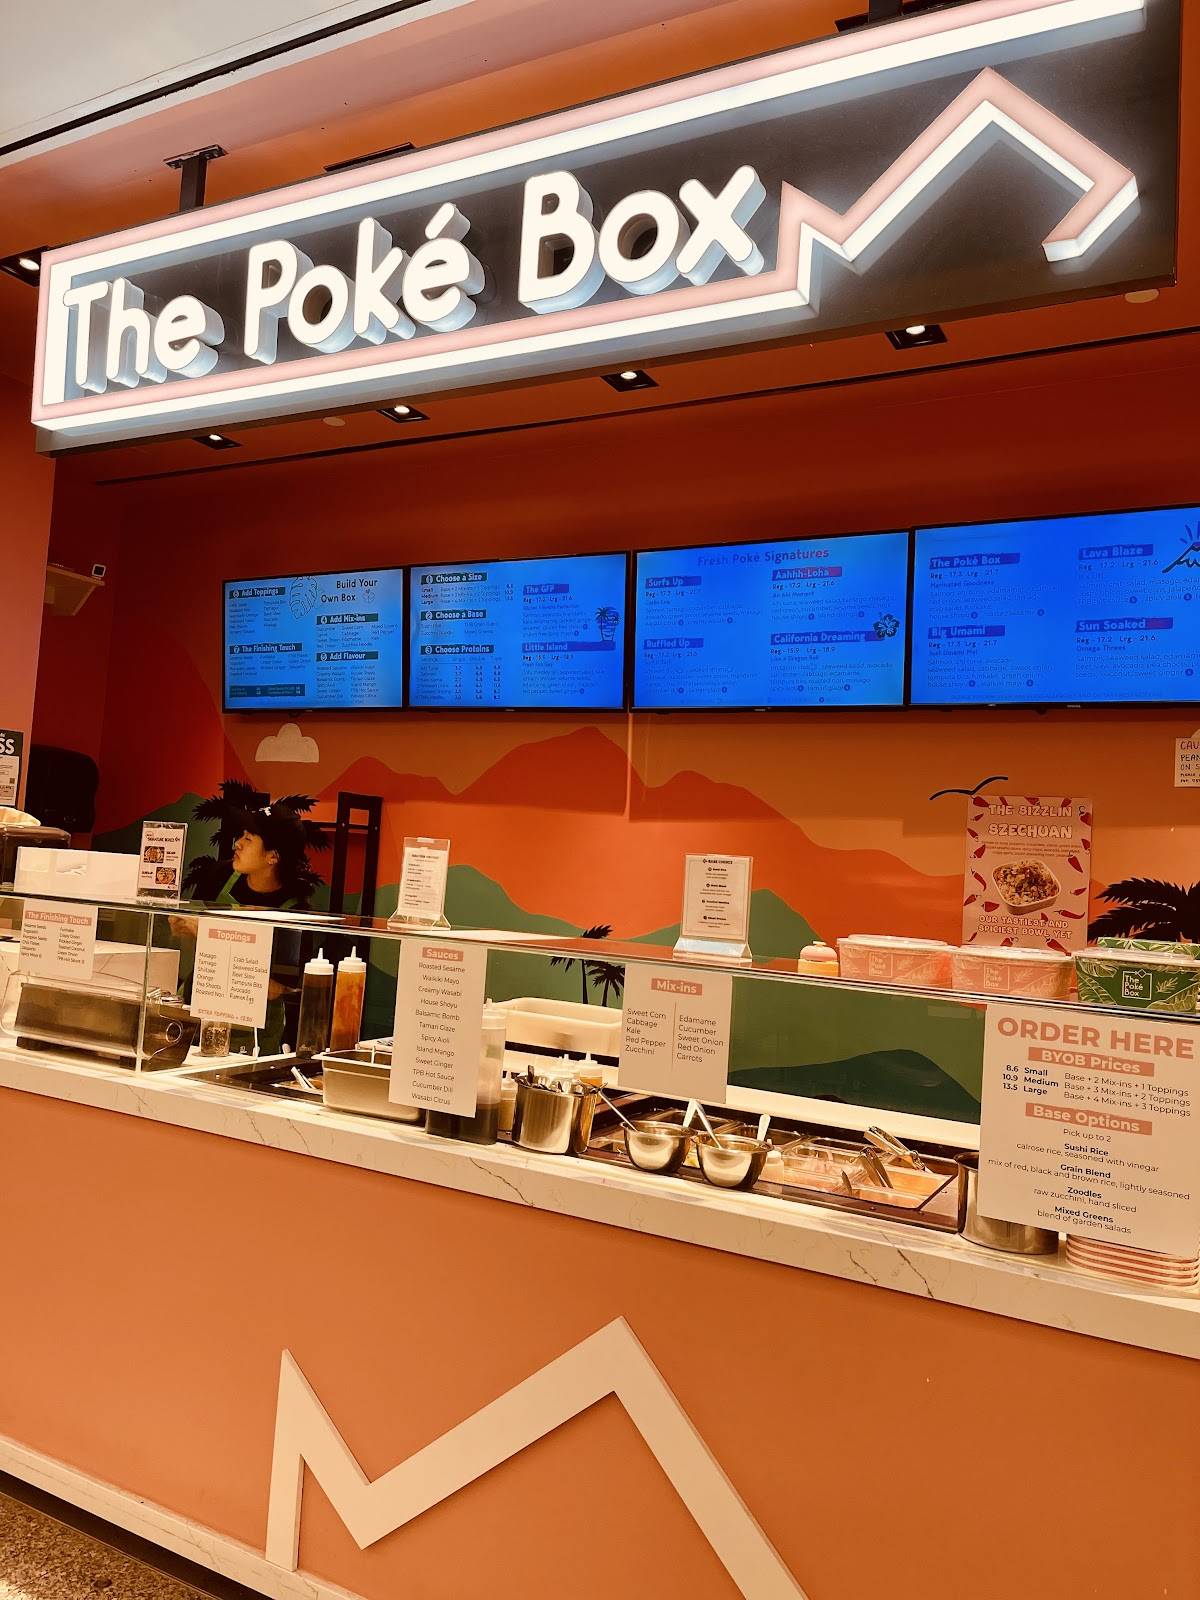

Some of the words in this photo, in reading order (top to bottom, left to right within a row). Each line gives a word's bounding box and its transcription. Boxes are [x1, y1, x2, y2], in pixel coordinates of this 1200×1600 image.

[62, 277, 218, 392] The
[244, 202, 480, 364] Poké
[518, 165, 764, 313] Box
[698, 557, 728, 566] Fresh
[733, 552, 760, 564] Poké
[764, 549, 830, 564] Signatures
[1082, 549, 1108, 558] Lava
[1112, 546, 1144, 556] Blaze
[932, 559, 950, 568] The
[954, 556, 978, 566] Poké
[981, 556, 1000, 565] Box
[436, 574, 460, 582] Choose
[468, 573, 482, 581] Size
[336, 579, 356, 589] Build
[358, 578, 378, 588] Your
[254, 588, 279, 597] Toppings
[320, 594, 338, 602] Own
[341, 594, 356, 602] Box
[436, 611, 460, 619] Choose
[950, 626, 986, 636] Umami
[1079, 622, 1100, 631] Sun
[1103, 620, 1146, 630] Soaked
[774, 634, 818, 644] California
[821, 632, 866, 642] Dreaming
[254, 644, 278, 653] Finishing
[435, 645, 460, 653] Choose
[461, 644, 490, 653] Proteins
[524, 643, 545, 651] Little
[344, 652, 366, 660] Flavour
[988, 804, 1013, 816] THE
[1018, 805, 1072, 817] SIZZLIN
[988, 823, 1072, 839] SZECHUAN
[40, 913, 68, 923] Finishing
[70, 916, 89, 924] Touch
[979, 915, 997, 924] OUR
[1002, 916, 1045, 926] TASTIEST
[1048, 919, 1068, 928] AND
[216, 930, 251, 943] Toppings
[978, 924, 1019, 935] SPICIEST
[1022, 928, 1050, 937] BOWL
[1053, 930, 1072, 939] YET
[426, 949, 459, 960] Sauces
[419, 962, 441, 970] Roasted
[442, 965, 465, 973] Sesame
[1124, 975, 1139, 983] The
[418, 986, 439, 995] Creamy
[656, 980, 697, 994] Mix-ins
[1124, 982, 1143, 990] Poké
[440, 1000, 458, 1009] Shoyu
[442, 1013, 460, 1021] Bomb
[627, 1009, 648, 1017] Sweet
[650, 1011, 666, 1019] Corn
[627, 1018, 658, 1028] Cabbage
[680, 1015, 716, 1026] Edamame
[679, 1025, 717, 1036] Cucumber
[421, 1034, 436, 1042] Spicy
[641, 1038, 666, 1047] Pepper
[678, 1034, 700, 1043] Sweet
[702, 1037, 724, 1046] Onion
[998, 1017, 1100, 1048] ORDER
[1111, 1030, 1194, 1059] HERE
[417, 1045, 433, 1054] Island
[434, 1048, 454, 1057] Mango
[625, 1045, 655, 1055] Zucchini
[678, 1043, 692, 1051] Red
[694, 1046, 716, 1055] Onion
[416, 1057, 432, 1065] Sweet
[434, 1060, 453, 1069] Ginger
[677, 1053, 702, 1062] Carrots
[1041, 1050, 1086, 1066] BYOB
[1091, 1054, 1140, 1073] Prices
[437, 1072, 454, 1080] Sauce
[1006, 1065, 1019, 1073] 8.6
[1024, 1067, 1048, 1076] Small
[1065, 1073, 1085, 1082] Base
[1102, 1077, 1132, 1088] Mix-ins
[1147, 1084, 1189, 1097] Toppings
[412, 1080, 442, 1091] Cucumber
[1003, 1074, 1018, 1082] 10.9
[1024, 1076, 1059, 1088] Medium
[1064, 1082, 1084, 1092] Base
[1101, 1087, 1132, 1098] Mix-ins
[1150, 1094, 1190, 1107] Toppings
[412, 1093, 432, 1102] Wasabi
[1003, 1083, 1018, 1091] 13.5
[1024, 1086, 1048, 1095] Large
[1064, 1091, 1084, 1101] Base
[1102, 1097, 1132, 1108] Mix-ins
[1150, 1104, 1190, 1117] Toppings
[1033, 1105, 1071, 1121] Base
[1075, 1112, 1140, 1132] Options
[1063, 1129, 1080, 1137] Pick
[1064, 1143, 1088, 1154] Sushi
[1089, 1147, 1109, 1157] Rice
[1047, 1147, 1063, 1156] rice,
[1065, 1150, 1103, 1162] seasoned
[1105, 1157, 1125, 1167] with
[1127, 1160, 1159, 1172] vinegar
[1060, 1164, 1082, 1174] Grain
[1085, 1168, 1111, 1178] Blend
[1014, 1162, 1029, 1172] red,
[1031, 1166, 1051, 1176] black
[1054, 1169, 1069, 1179] and
[1072, 1172, 1098, 1184] brown
[1100, 1178, 1118, 1189] rice,
[1120, 1181, 1146, 1194] lightly
[1148, 1186, 1190, 1200] seasoned
[1067, 1186, 1102, 1199] Zoodles
[1050, 1191, 1086, 1204] zucchini,
[1088, 1197, 1110, 1208] hand
[1112, 1202, 1137, 1213] sliced
[1054, 1206, 1080, 1216] Mixed
[1083, 1211, 1114, 1223] Greens
[1037, 1209, 1061, 1221] blend
[1062, 1213, 1071, 1222] of
[1072, 1215, 1103, 1229] garden
[1104, 1221, 1131, 1234] salads
